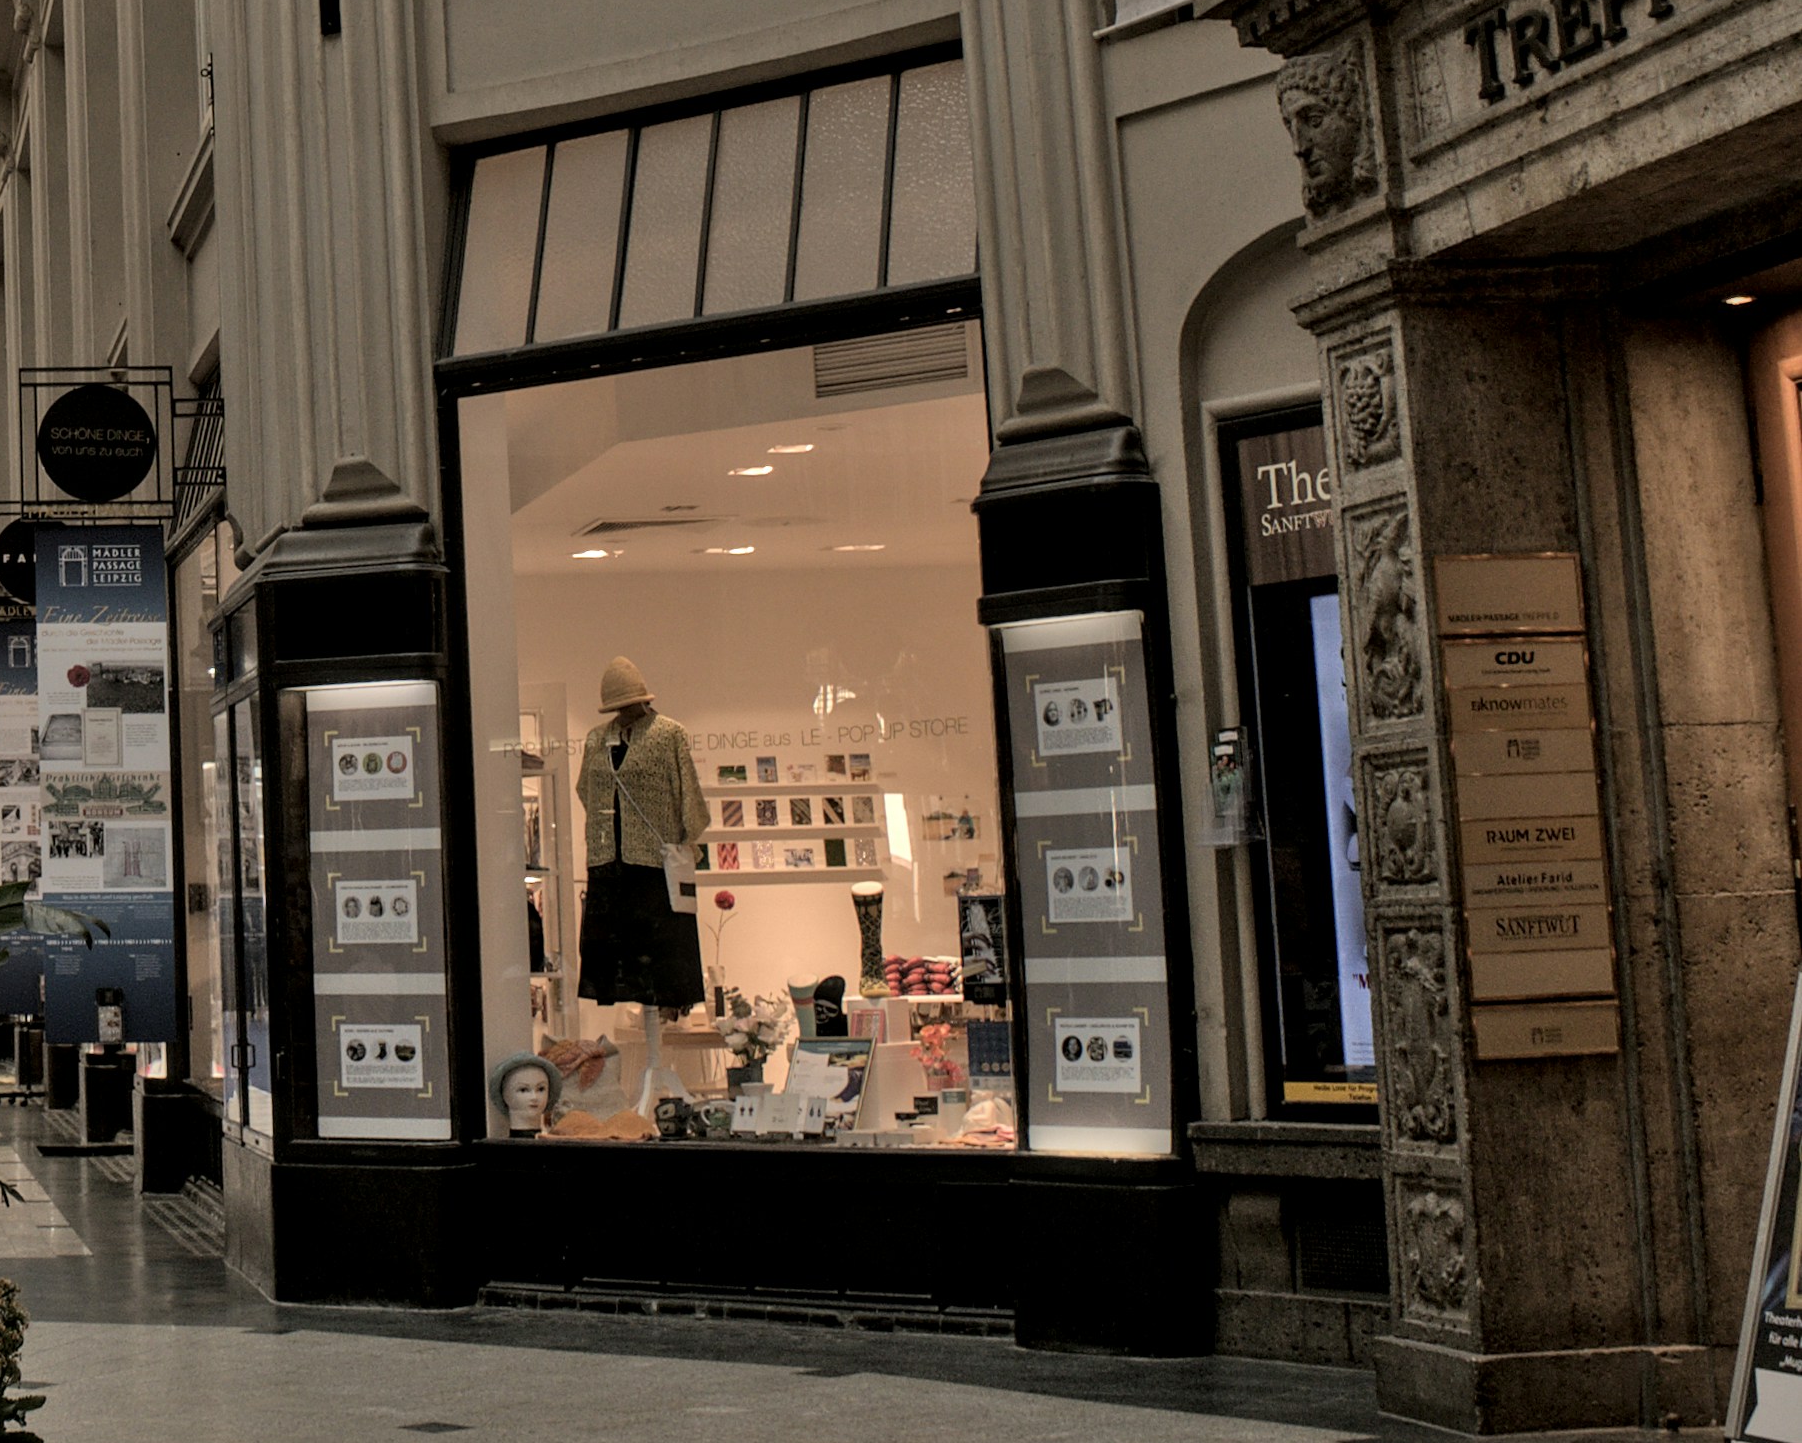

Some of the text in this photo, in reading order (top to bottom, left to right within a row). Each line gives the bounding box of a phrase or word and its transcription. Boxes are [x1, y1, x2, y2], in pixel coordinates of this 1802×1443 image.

[50, 426, 104, 441] SCHÖNE
[51, 445, 144, 458] von uns zu euch
[92, 560, 142, 571] PASSAGE
[92, 573, 143, 583] LEIPZIG
[42, 605, 162, 627] Eine Zeitreise
[1494, 650, 1535, 666] CDU
[707, 731, 758, 751] DINGE
[764, 734, 791, 749] aus
[801, 728, 821, 747] LE
[838, 725, 875, 745] POP
[909, 716, 969, 738] STORE
[1486, 827, 1576, 844] RAUM ZWEI
[1496, 872, 1573, 886] Atelier Farid
